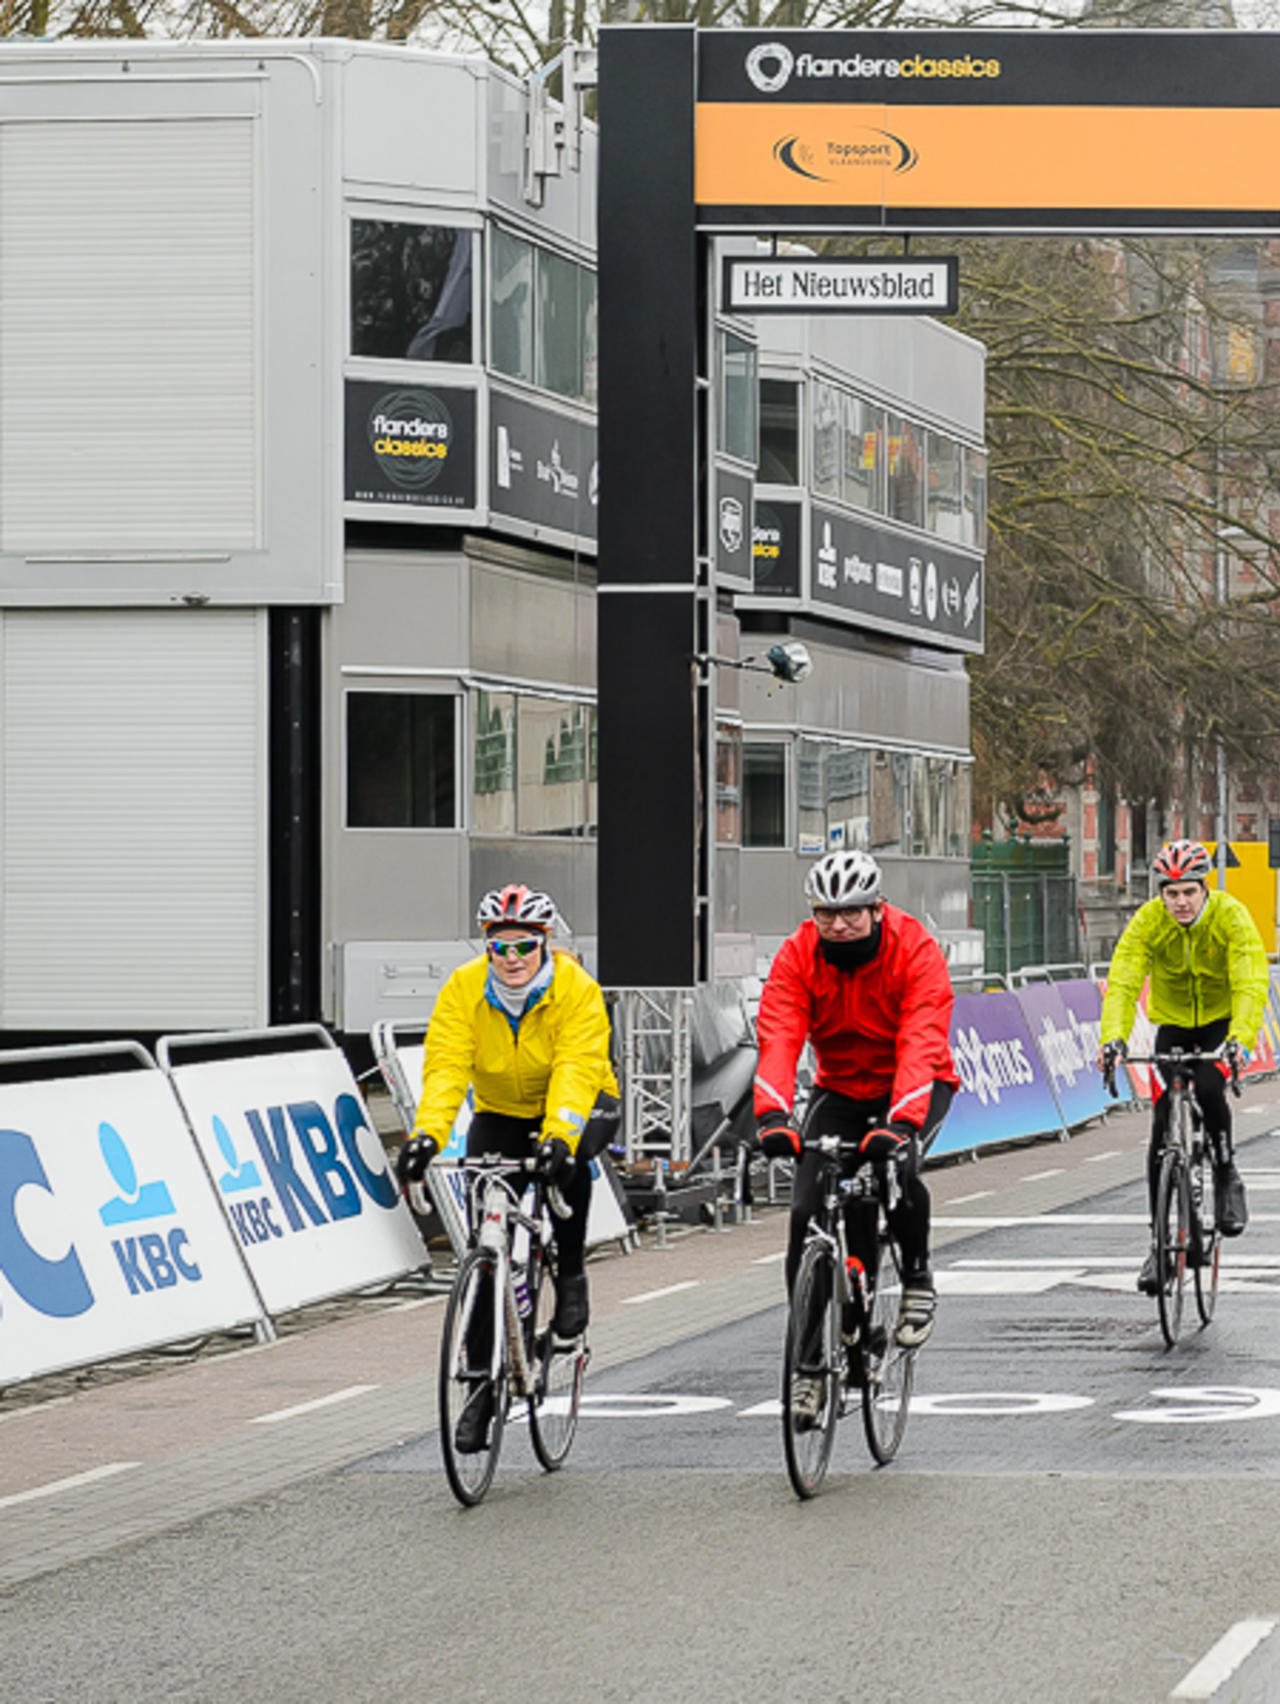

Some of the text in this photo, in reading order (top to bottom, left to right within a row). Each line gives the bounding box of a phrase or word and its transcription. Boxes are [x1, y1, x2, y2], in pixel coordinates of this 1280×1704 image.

[743, 270, 935, 299] Het Nieuwsblad
[372, 414, 449, 439] flanders
[372, 436, 448, 459] classics
[243, 1093, 400, 1232] KBC
[229, 1197, 284, 1247] KBC
[111, 1228, 203, 1296] KBC
